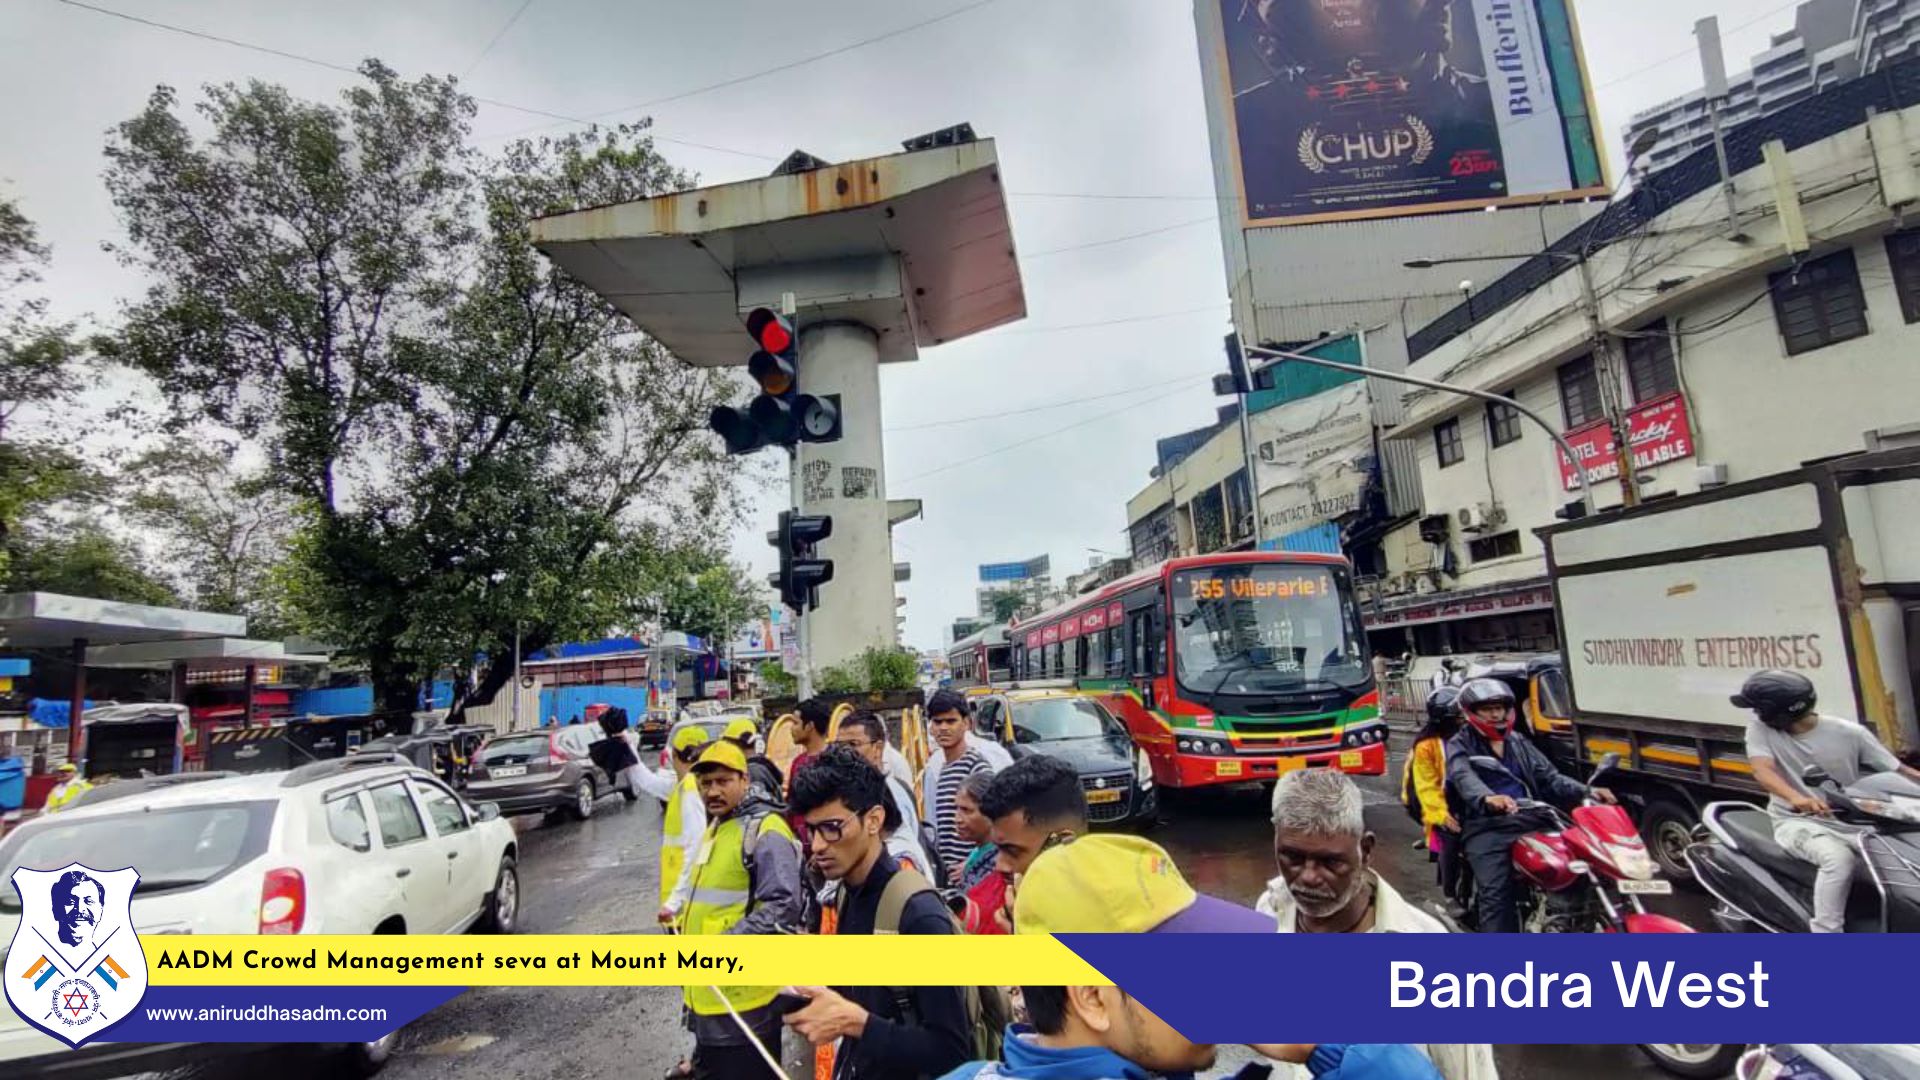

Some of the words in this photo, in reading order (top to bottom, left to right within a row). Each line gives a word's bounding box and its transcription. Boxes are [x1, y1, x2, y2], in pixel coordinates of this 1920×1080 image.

[1316, 130, 1413, 163] CHUP
[1583, 460, 1619, 483] OOMS
[1583, 638, 1687, 666] SIDDHIVINAYAK
[1694, 633, 1823, 669] ENTERPRISES
